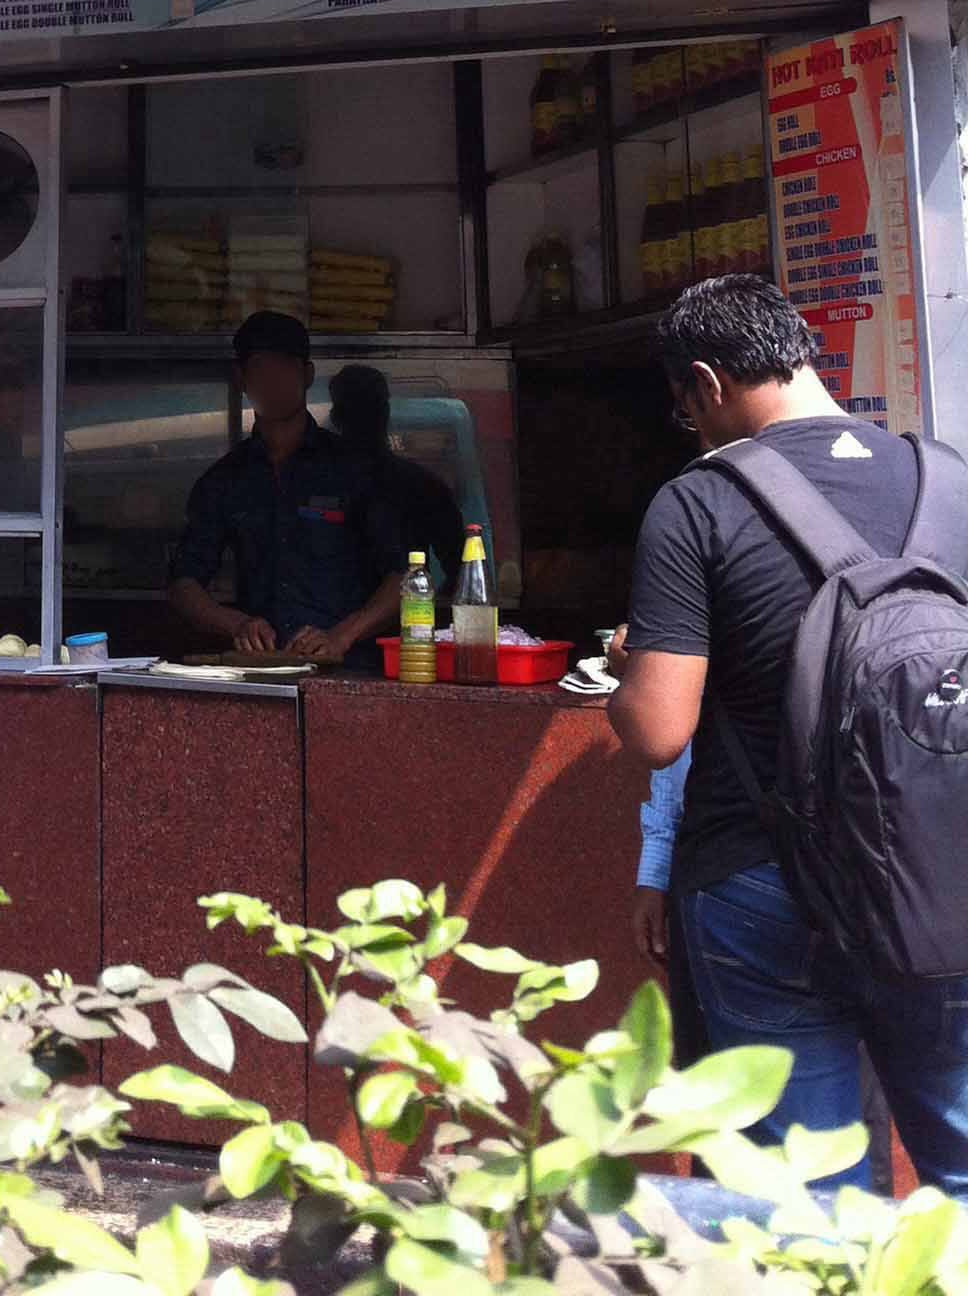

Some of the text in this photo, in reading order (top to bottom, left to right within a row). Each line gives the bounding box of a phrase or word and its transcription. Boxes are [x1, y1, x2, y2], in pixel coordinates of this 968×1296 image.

[820, 83, 841, 99] EGG
[816, 146, 857, 165] CHICKEN
[827, 306, 867, 321] MUTTON
